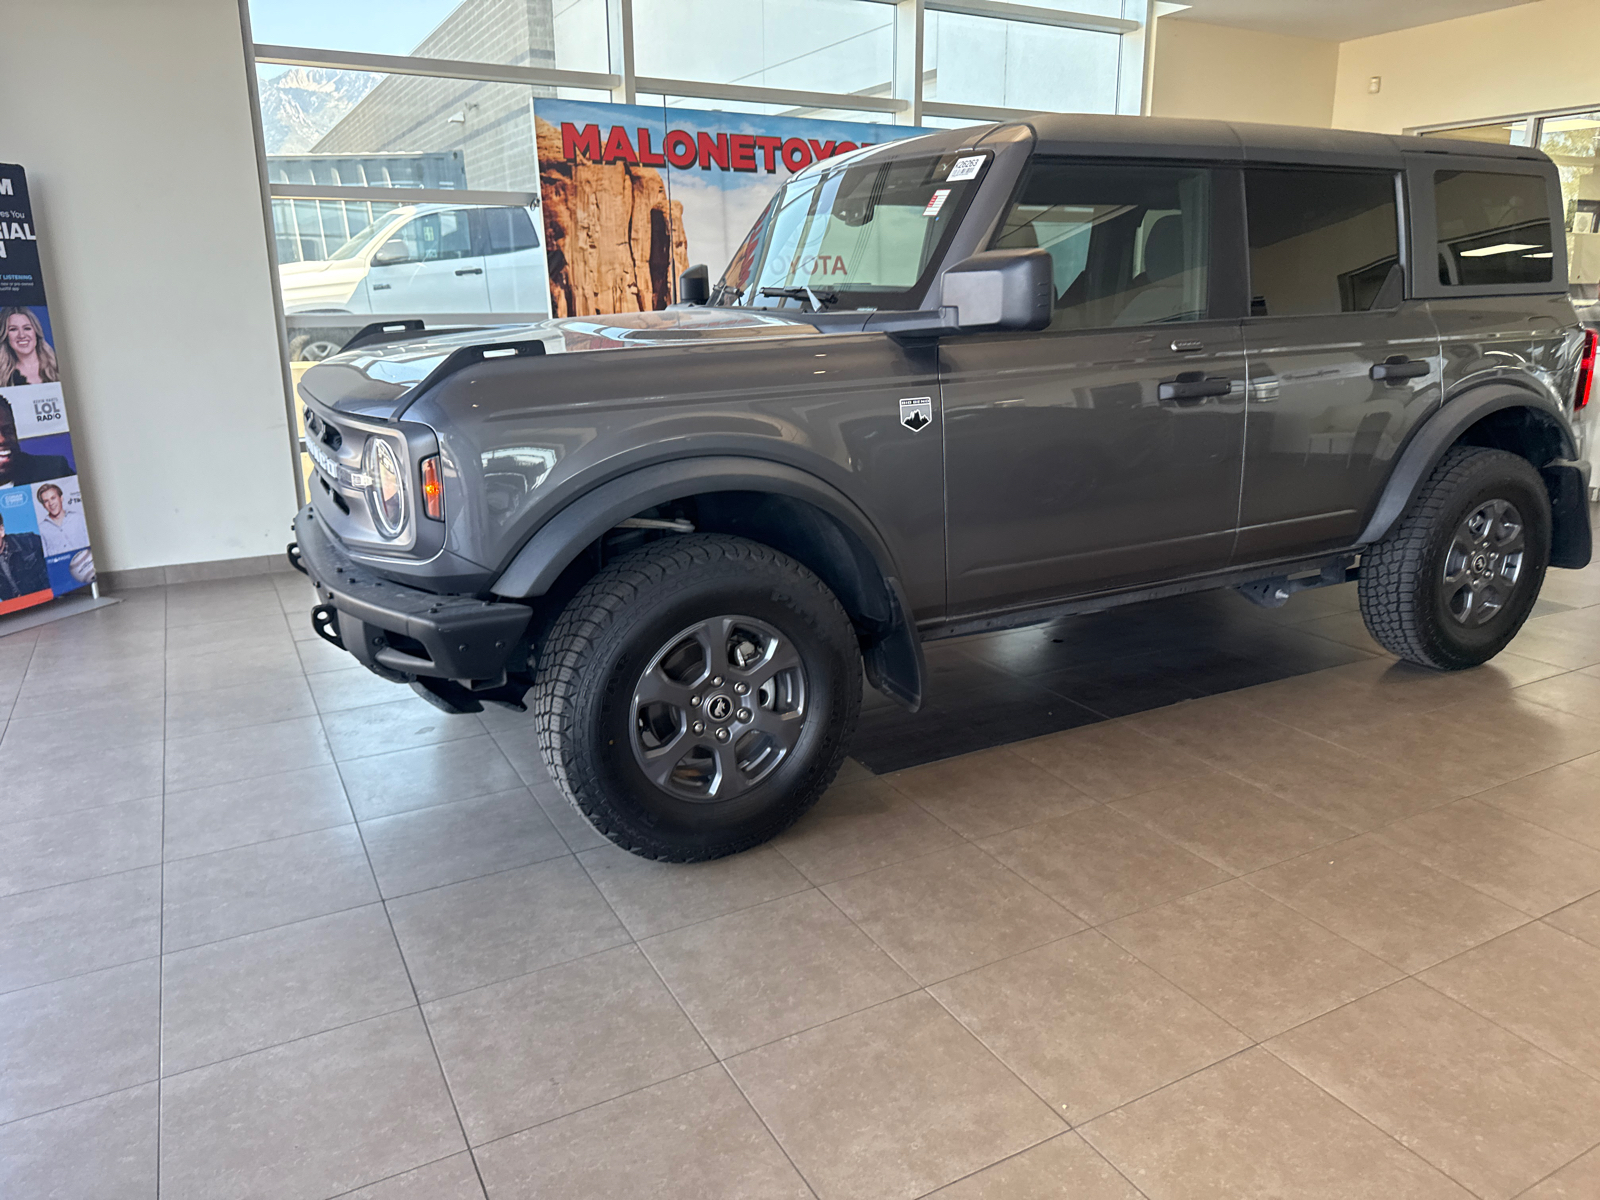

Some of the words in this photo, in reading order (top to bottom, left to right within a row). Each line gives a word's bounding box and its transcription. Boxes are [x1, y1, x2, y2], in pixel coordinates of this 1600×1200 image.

[561, 122, 877, 174] MALONETOY
[10, 210, 25, 219] You
[34, 402, 60, 415] LOL
[36, 412, 61, 422] RADIO
